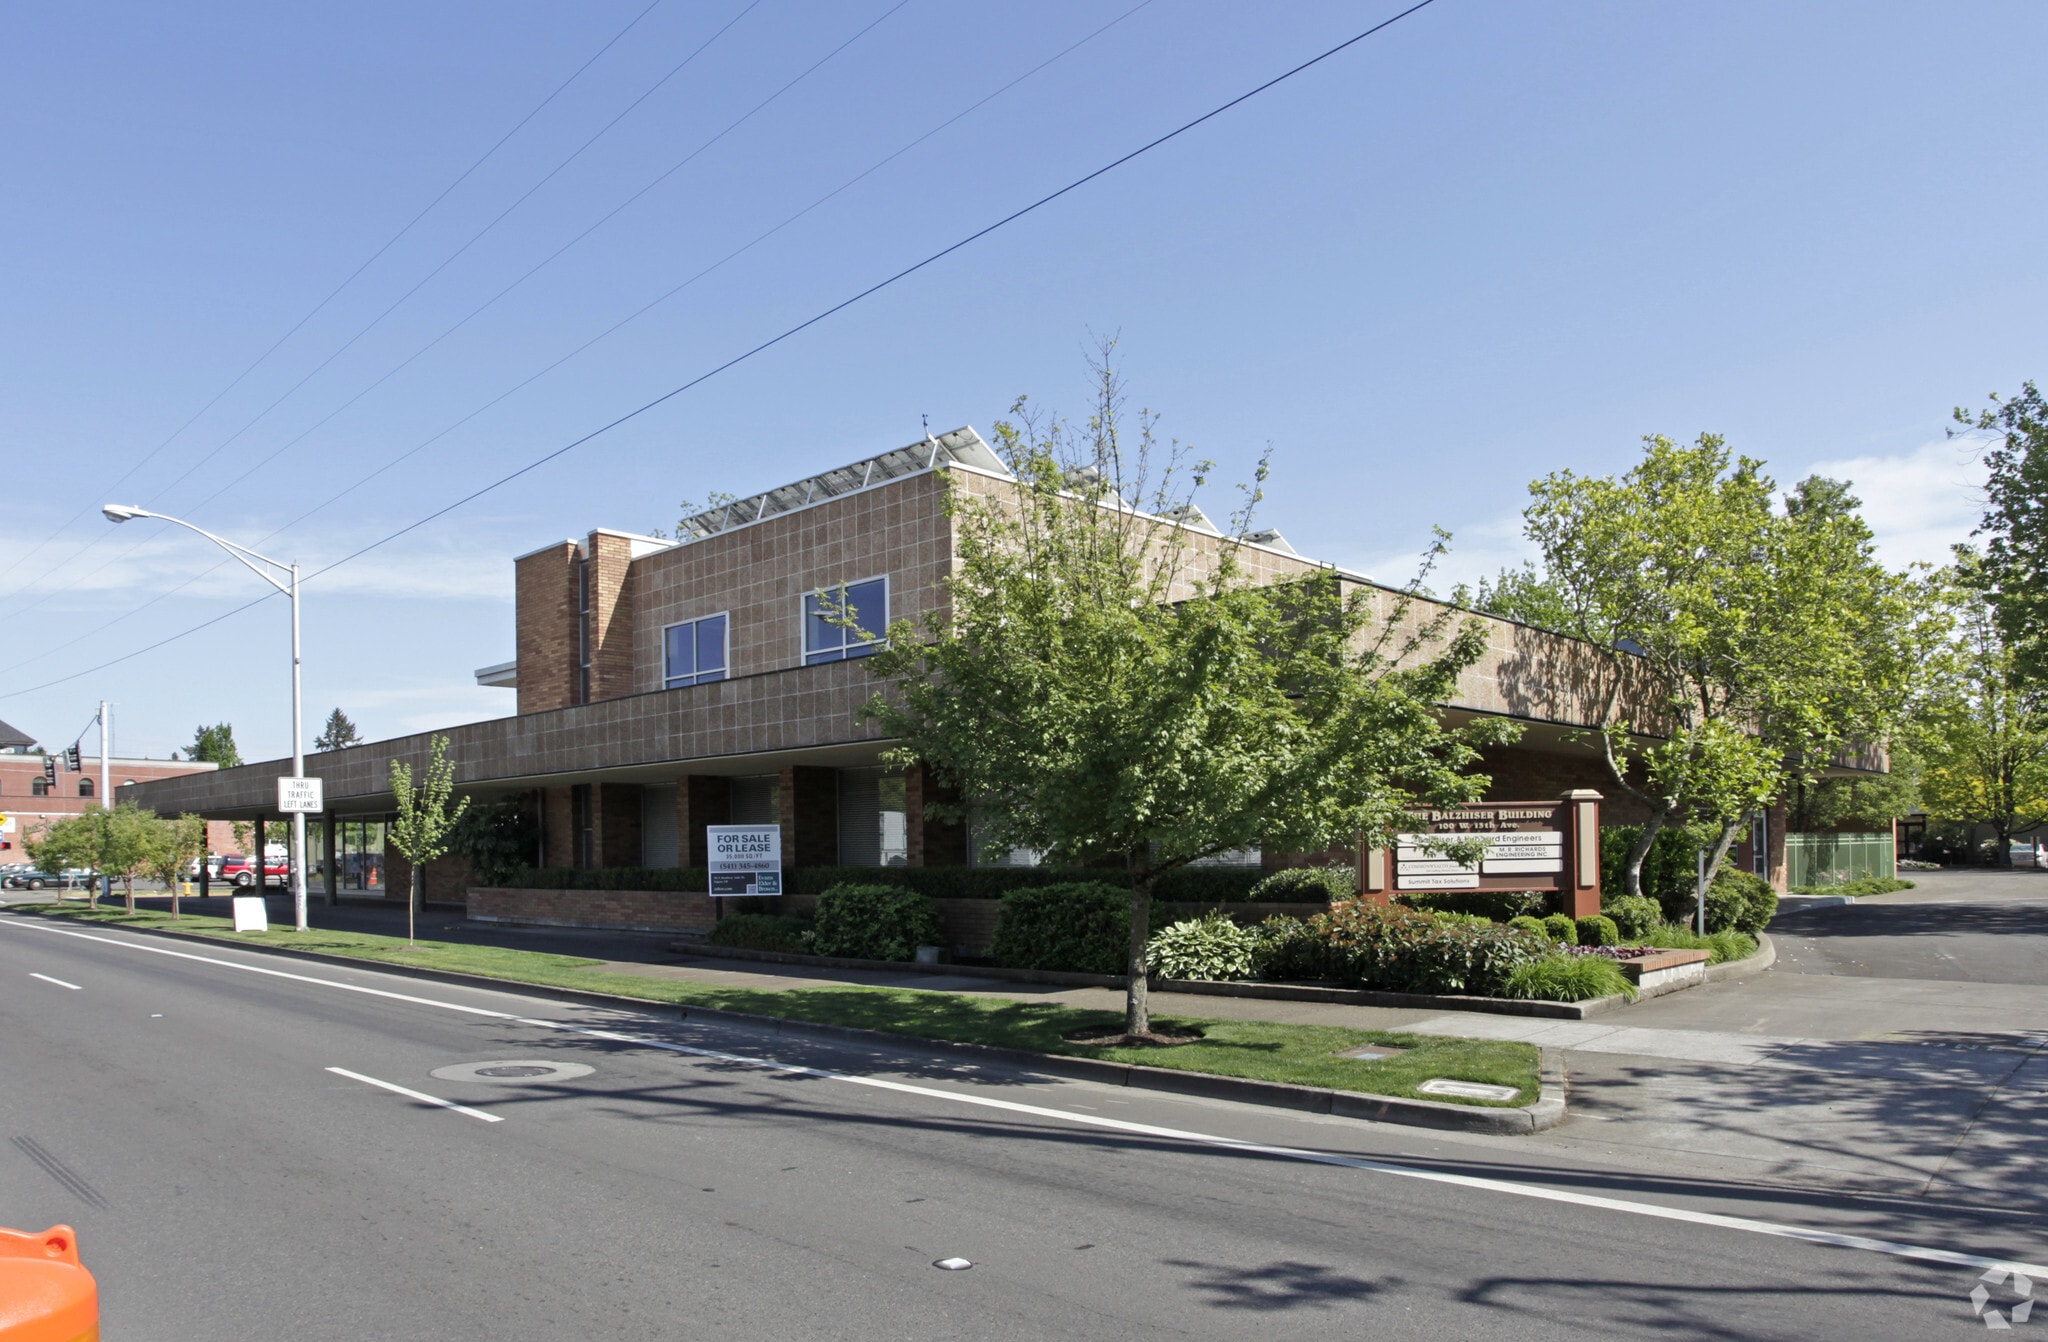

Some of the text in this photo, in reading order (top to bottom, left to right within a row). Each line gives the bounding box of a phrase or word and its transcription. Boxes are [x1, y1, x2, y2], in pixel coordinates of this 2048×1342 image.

[292, 781, 309, 790] THRU
[288, 791, 314, 799] TRAFFIC
[284, 801, 318, 809] LEFT LANES
[1432, 810, 1494, 822] BALZHISER
[1498, 809, 1553, 820] BUILDING
[1439, 822, 1455, 830] 100
[1500, 821, 1520, 829] Ave.
[717, 834, 771, 843] FOR SALE
[1502, 834, 1542, 843] Engineers
[717, 843, 771, 853] OR LEASE
